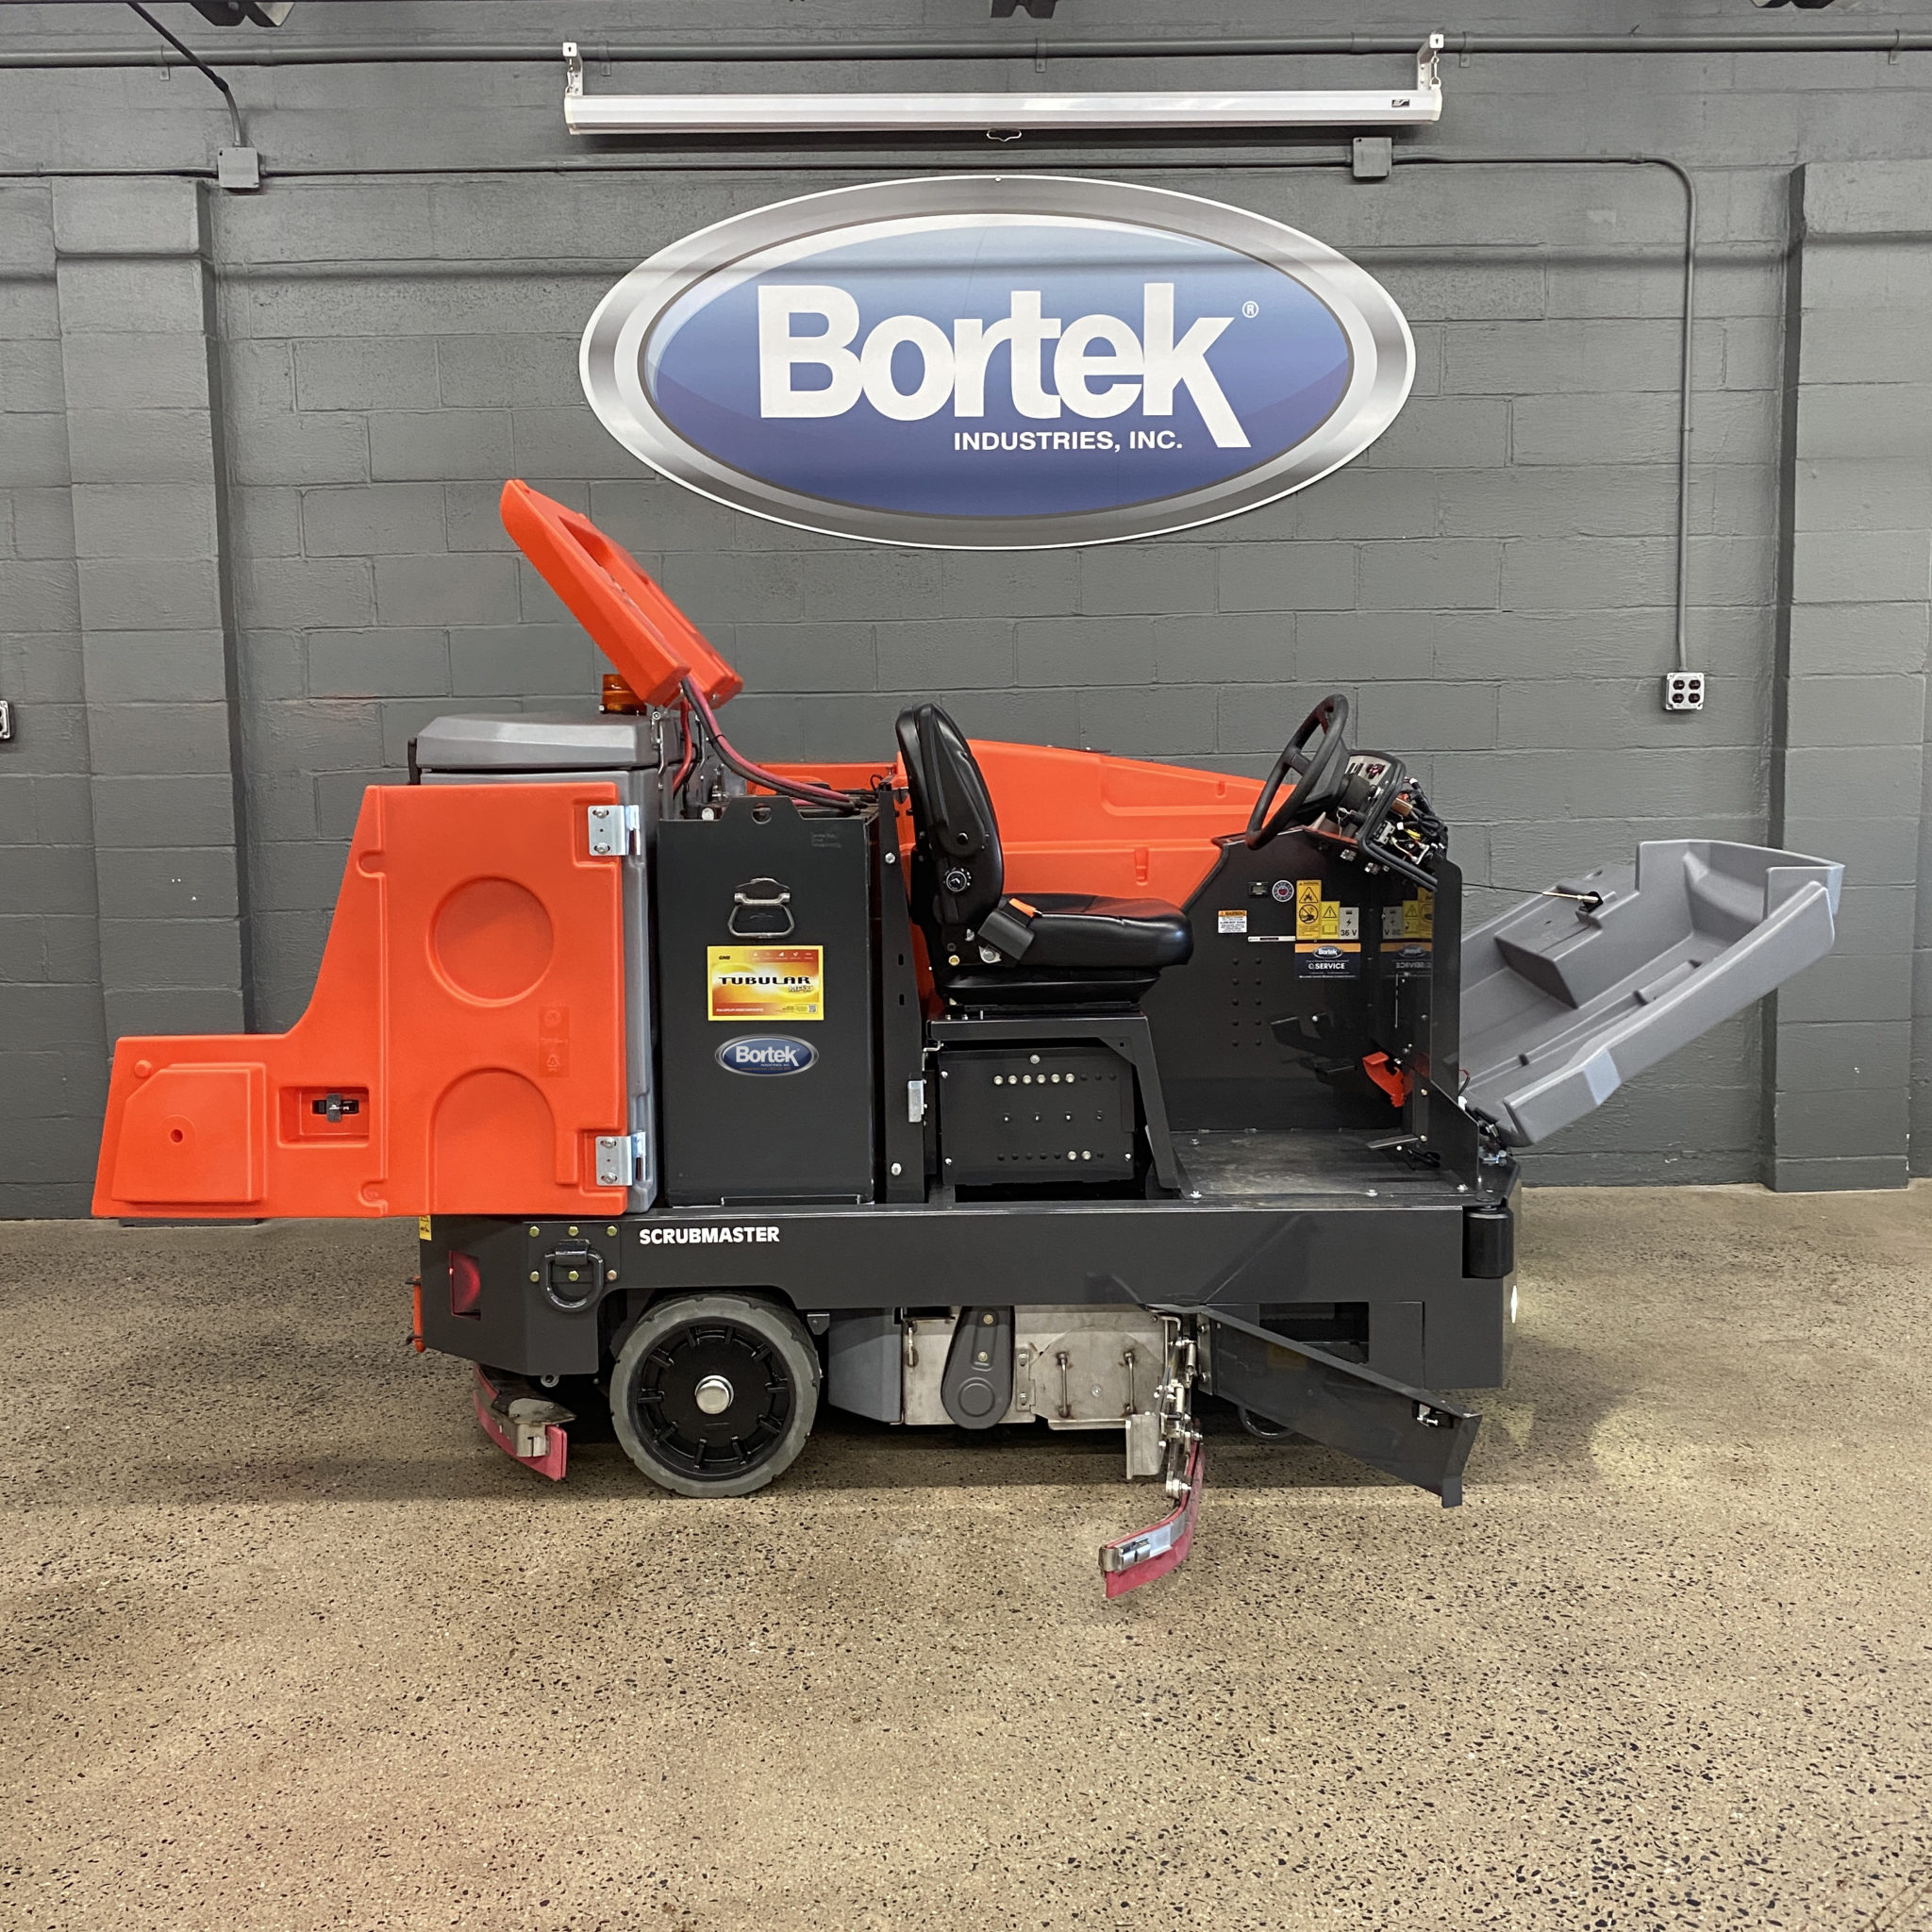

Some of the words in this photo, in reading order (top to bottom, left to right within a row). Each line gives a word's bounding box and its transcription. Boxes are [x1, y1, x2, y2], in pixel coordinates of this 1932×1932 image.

[758, 282, 1252, 449] Bortek
[954, 431, 1121, 452] INDUSTRIES,
[1129, 430, 1183, 449] INC.
[718, 976, 810, 985] TUBULAR
[736, 1045, 800, 1067] Bortek
[639, 1226, 780, 1245] SCRUBMASTER
